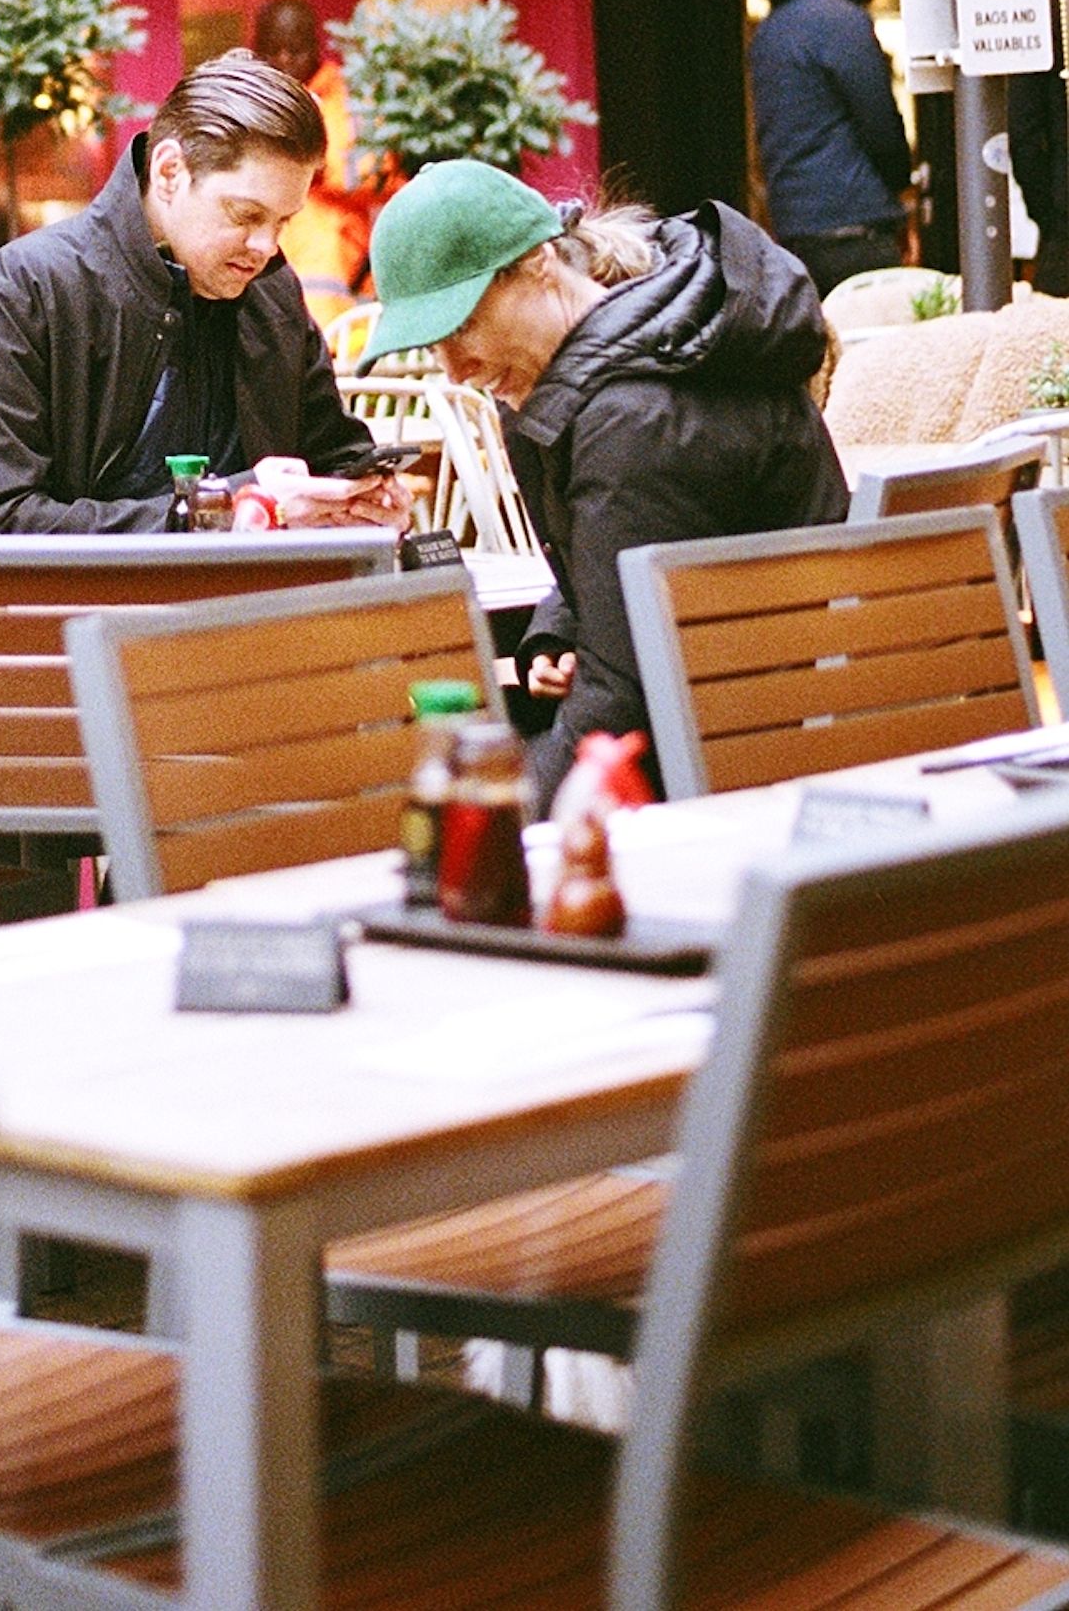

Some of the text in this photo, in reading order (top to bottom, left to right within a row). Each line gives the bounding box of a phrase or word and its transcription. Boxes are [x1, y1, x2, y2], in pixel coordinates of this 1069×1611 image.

[974, 8, 1037, 26] BAGS AND
[973, 36, 1042, 52] VALUABLES
